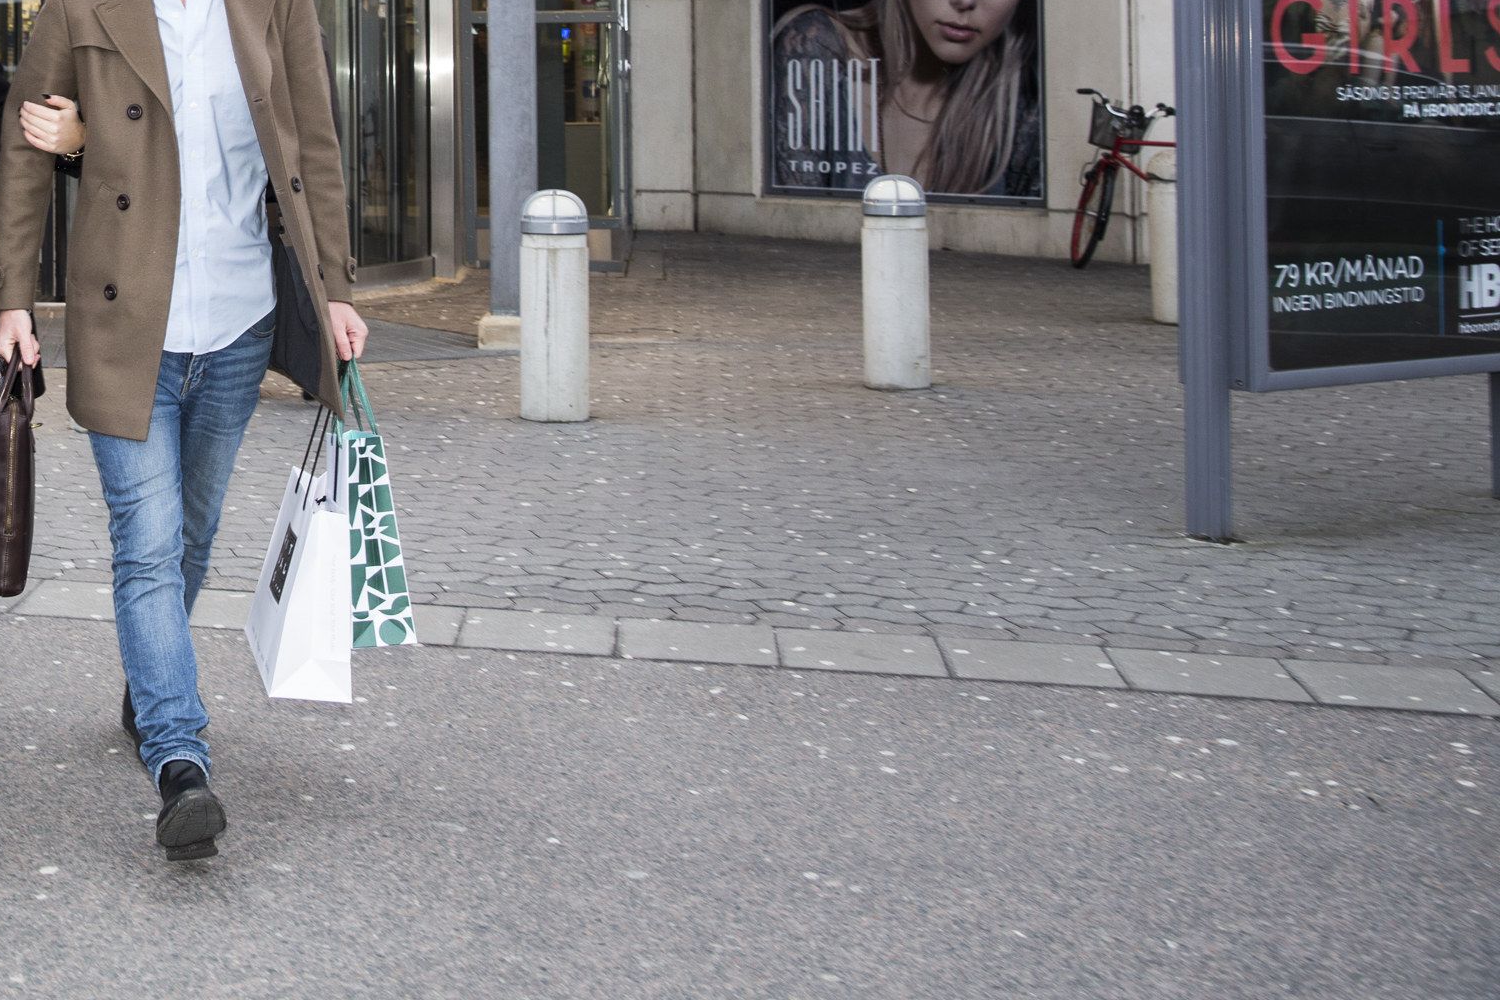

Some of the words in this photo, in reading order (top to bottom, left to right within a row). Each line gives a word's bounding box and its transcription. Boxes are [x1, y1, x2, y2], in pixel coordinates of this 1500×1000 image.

[787, 58, 880, 153] SAINT
[1335, 84, 1390, 100] SÄSONG
[788, 160, 878, 175] TROPEZ
[1274, 263, 1300, 288] 79
[1304, 254, 1424, 288] KR/MÅNAD
[1272, 294, 1322, 313] INGEN
[1324, 286, 1425, 309] BINDNINGSTID
